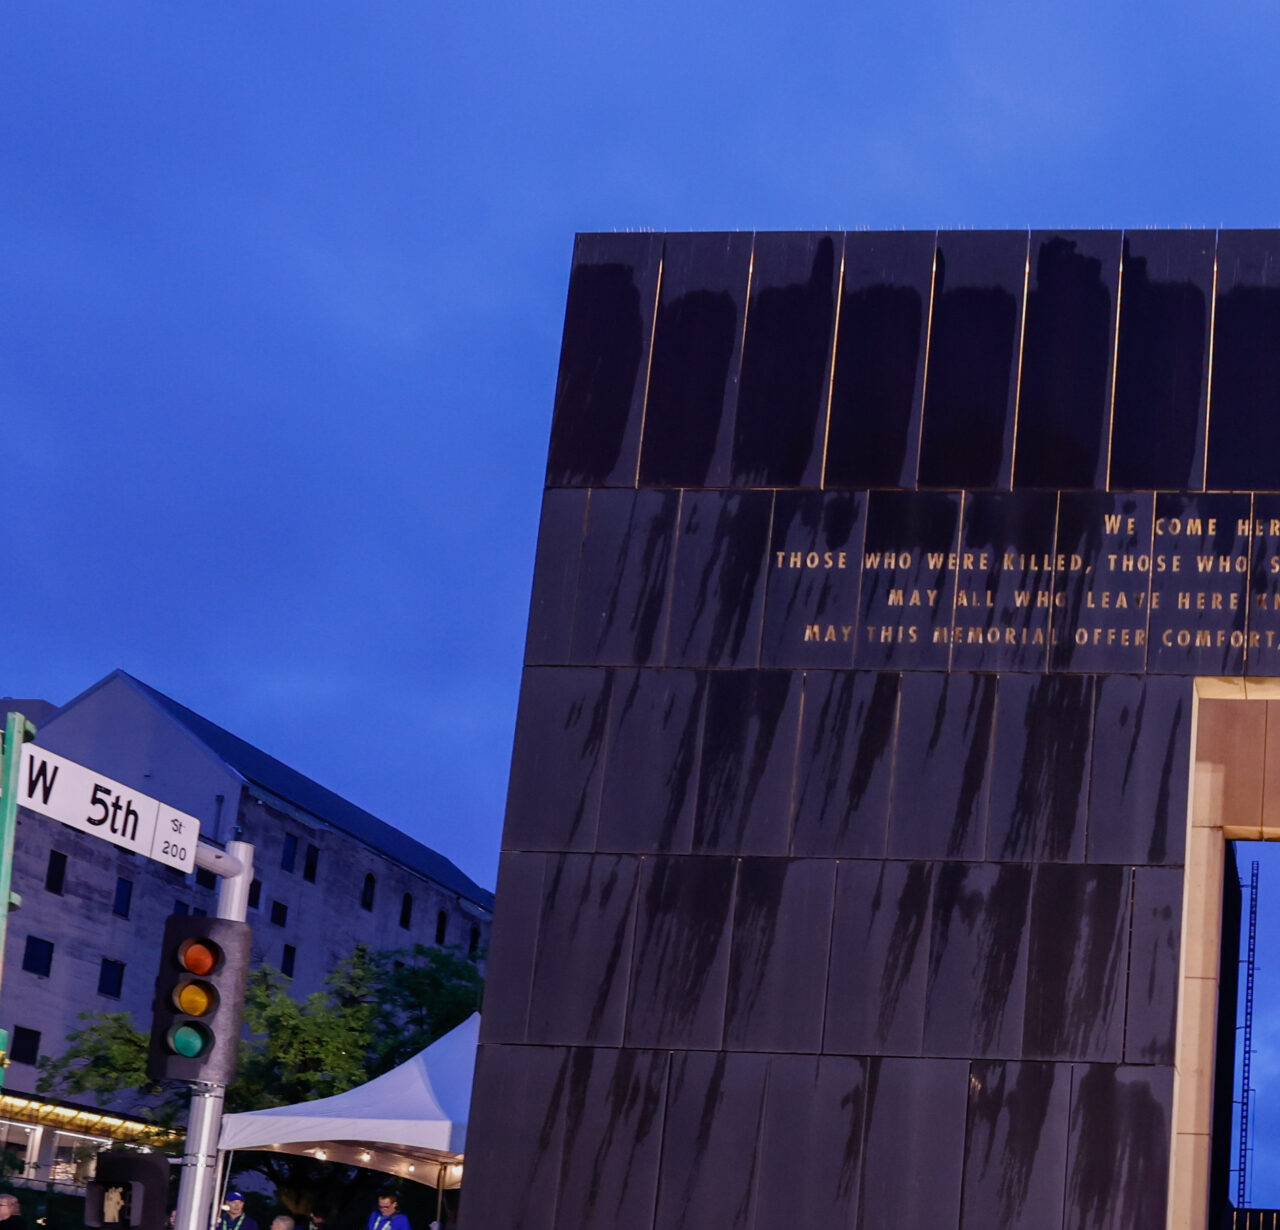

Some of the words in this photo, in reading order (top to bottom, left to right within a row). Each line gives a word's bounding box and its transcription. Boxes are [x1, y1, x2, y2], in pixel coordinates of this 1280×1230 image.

[1104, 514, 1136, 536] WE
[1156, 517, 1217, 536] COME
[776, 551, 847, 568] THOSE
[864, 552, 912, 570] WHO
[927, 552, 988, 570] WERE
[1003, 553, 1093, 574] KILLED,
[1108, 554, 1182, 573] THOSE
[1196, 555, 1248, 573] WHO
[888, 589, 938, 606] MAY
[957, 590, 994, 607] ALL
[1014, 590, 1067, 608] WHO
[1087, 591, 1160, 609] LEAVE
[1178, 592, 1239, 610] HERE
[804, 624, 852, 642] MAY
[867, 625, 918, 643] THIS
[933, 626, 1058, 645] MEMORIAL
[1075, 628, 1146, 646] OFFER
[27, 754, 59, 805] W
[86, 783, 139, 841] 5th
[172, 818, 185, 835] St
[162, 840, 187, 861] 200
